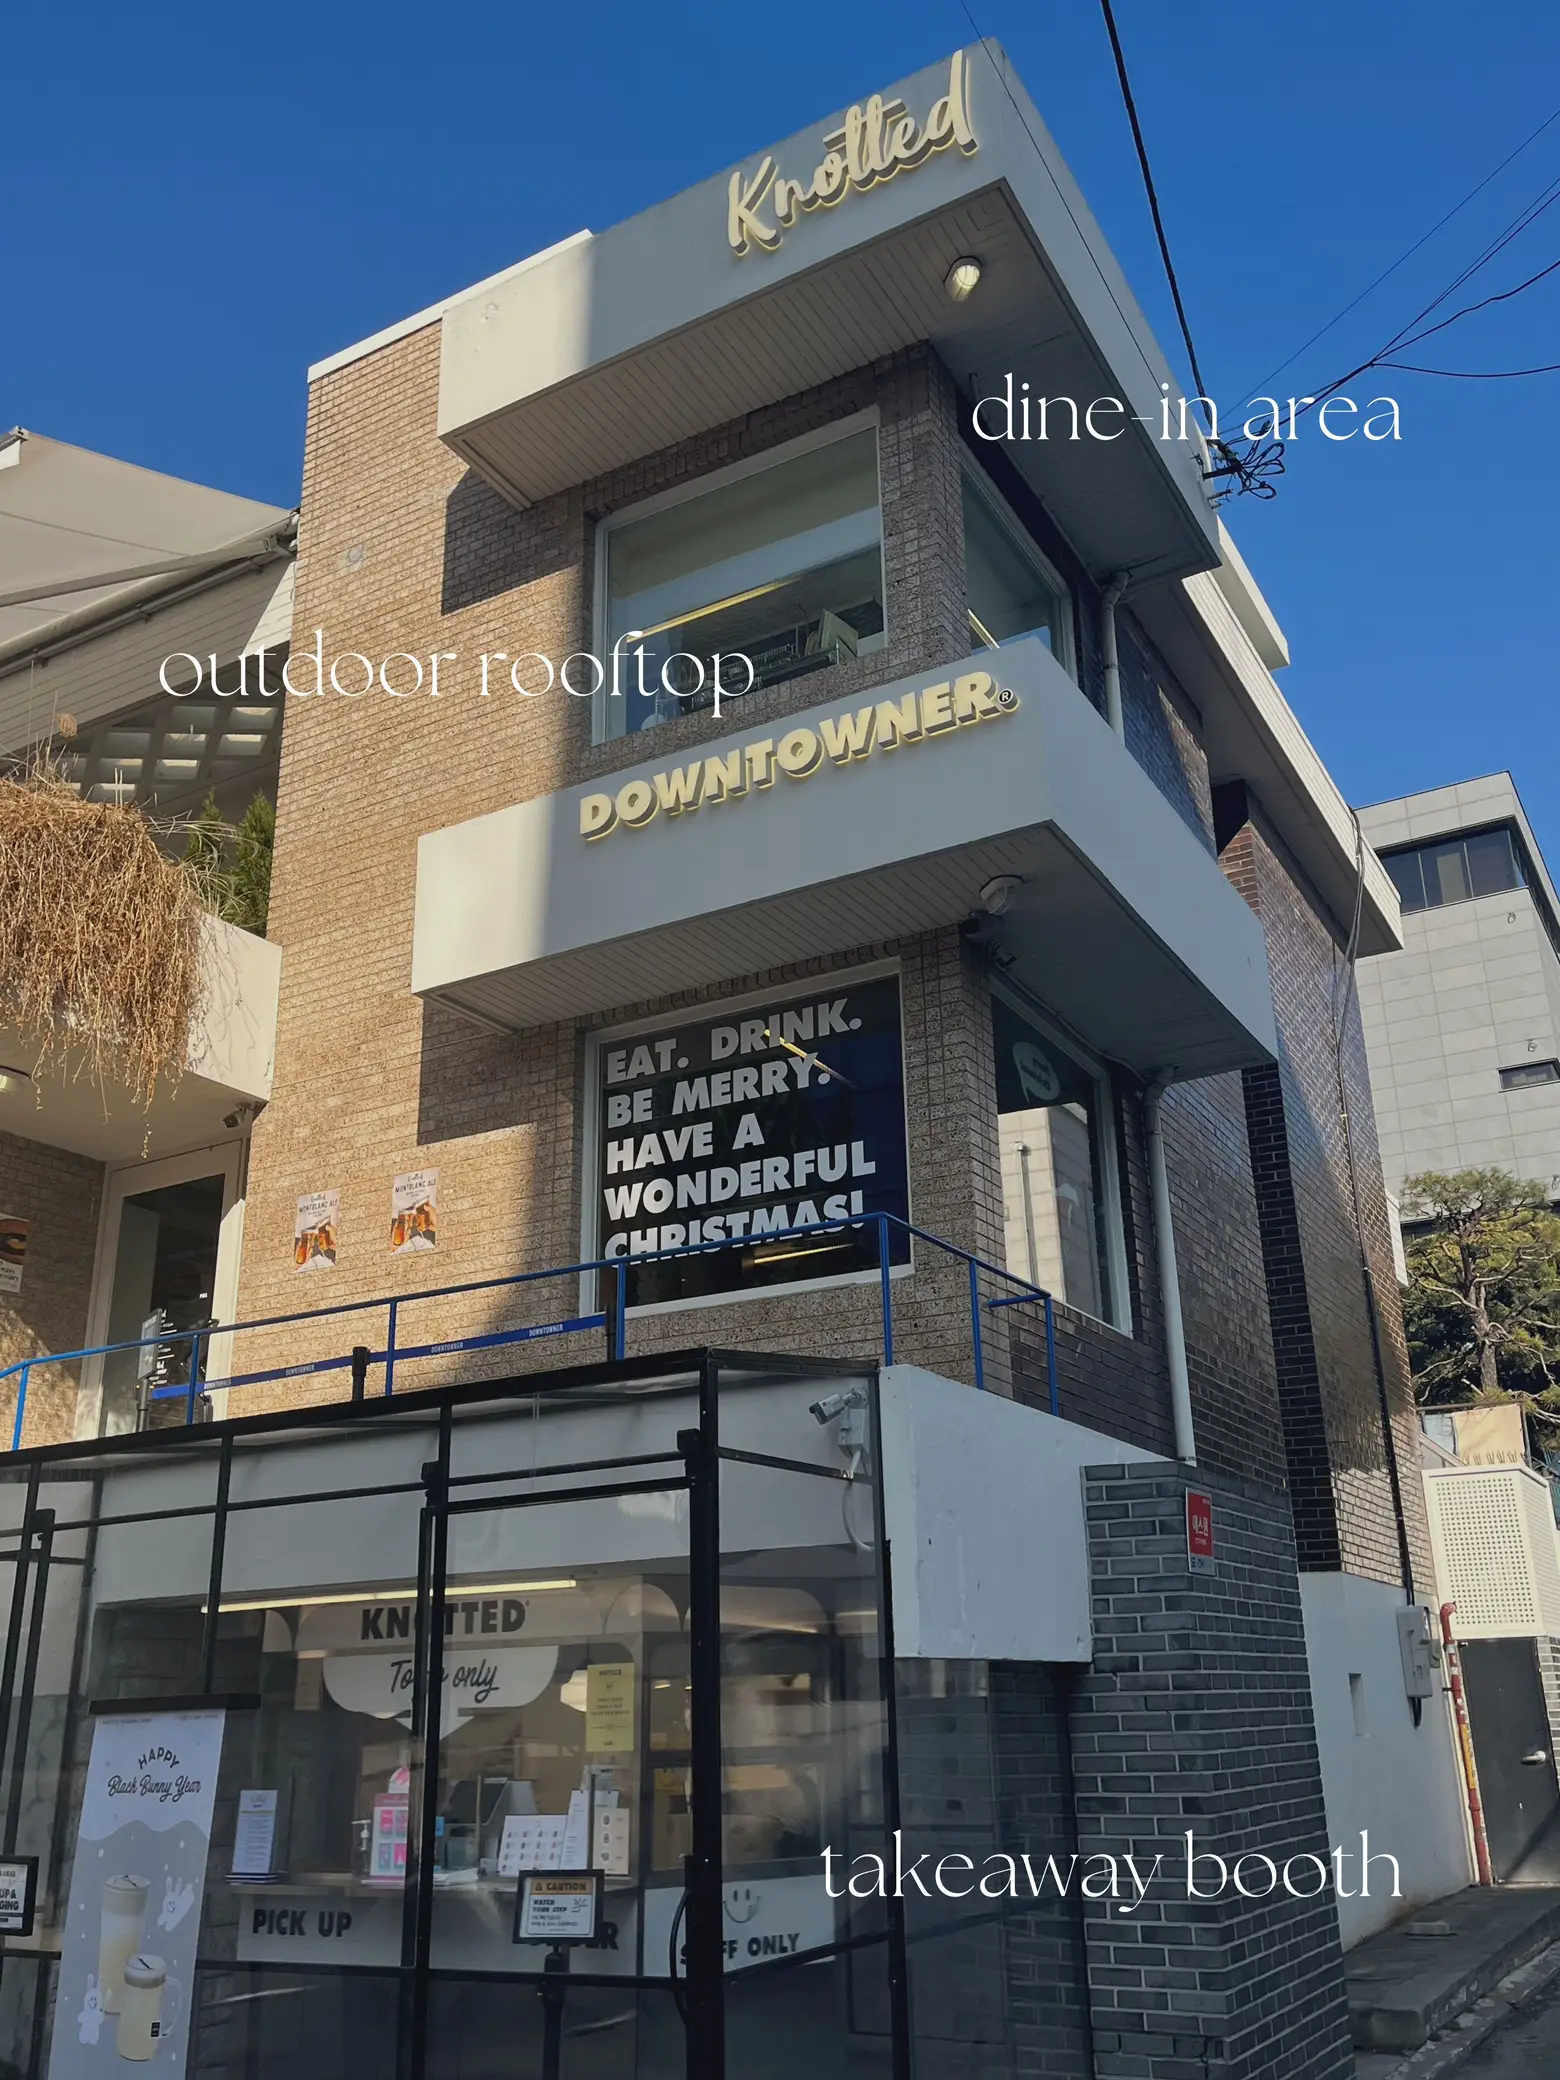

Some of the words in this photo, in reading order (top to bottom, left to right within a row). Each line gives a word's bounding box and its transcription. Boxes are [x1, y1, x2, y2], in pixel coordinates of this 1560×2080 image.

[727, 48, 979, 257] Knotted
[606, 1037, 690, 1085] EAT.
[710, 997, 863, 1062] DRINK.
[607, 1088, 653, 1129] BE
[671, 1051, 832, 1116] MERRY.
[606, 1121, 714, 1175] HAVE
[731, 1112, 766, 1150] A
[603, 1140, 877, 1222] WONDERFUL
[603, 1189, 865, 1269] CHRISTMAS!
[361, 1599, 526, 1640] KNTTED
[452, 1658, 500, 1704] only
[138, 1746, 180, 1770] HAPPY
[107, 1774, 138, 1797] Black
[139, 1774, 173, 1803] Bunny
[172, 1774, 202, 1803] Year
[546, 1882, 586, 1891] CAUTION
[252, 1908, 308, 1936] PICK
[318, 1910, 352, 1938] UP
[747, 1933, 800, 1957] ONLY
